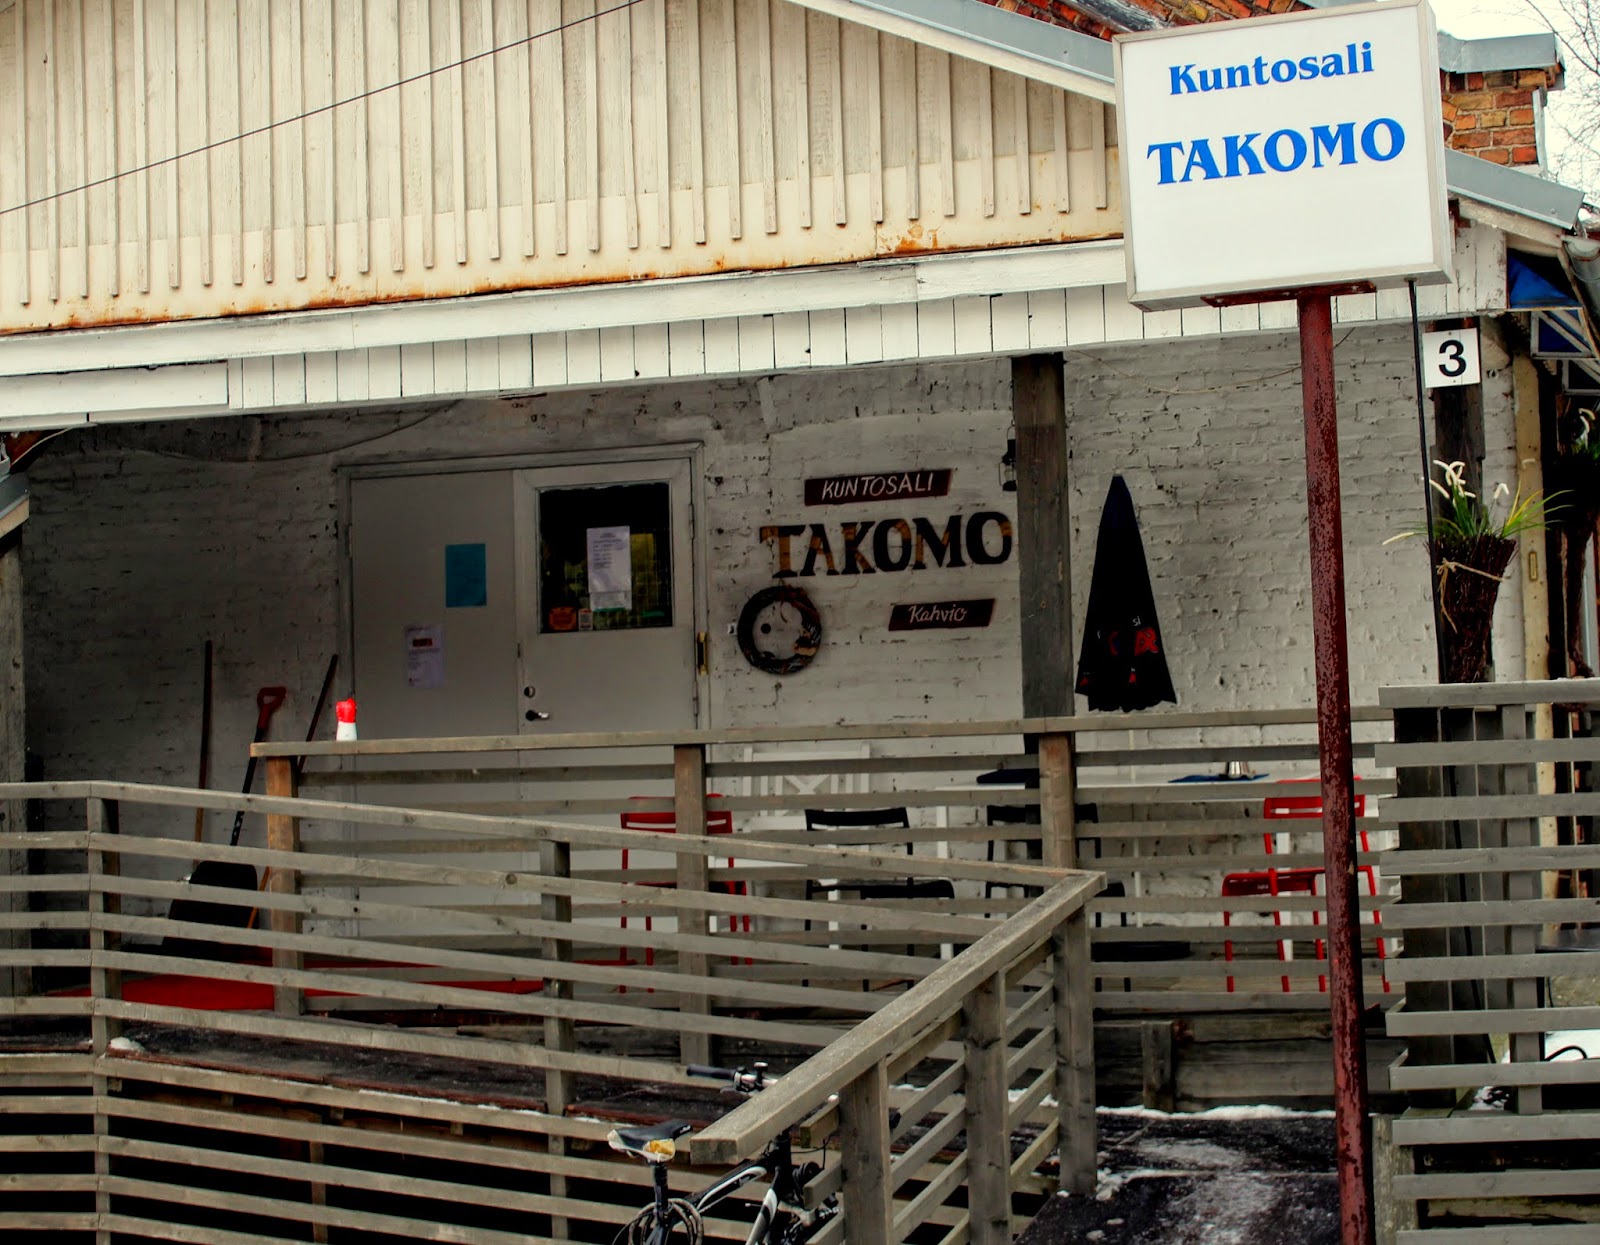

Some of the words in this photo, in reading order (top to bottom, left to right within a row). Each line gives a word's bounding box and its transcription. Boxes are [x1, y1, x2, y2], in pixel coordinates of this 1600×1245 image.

[1169, 41, 1375, 95] Kuntosali
[1146, 117, 1406, 185] TAKOMO
[1438, 339, 1467, 377] 3
[821, 472, 934, 500] KUNTOSALI
[759, 511, 1014, 579] TAKOMO
[908, 603, 967, 624] Kahvio
